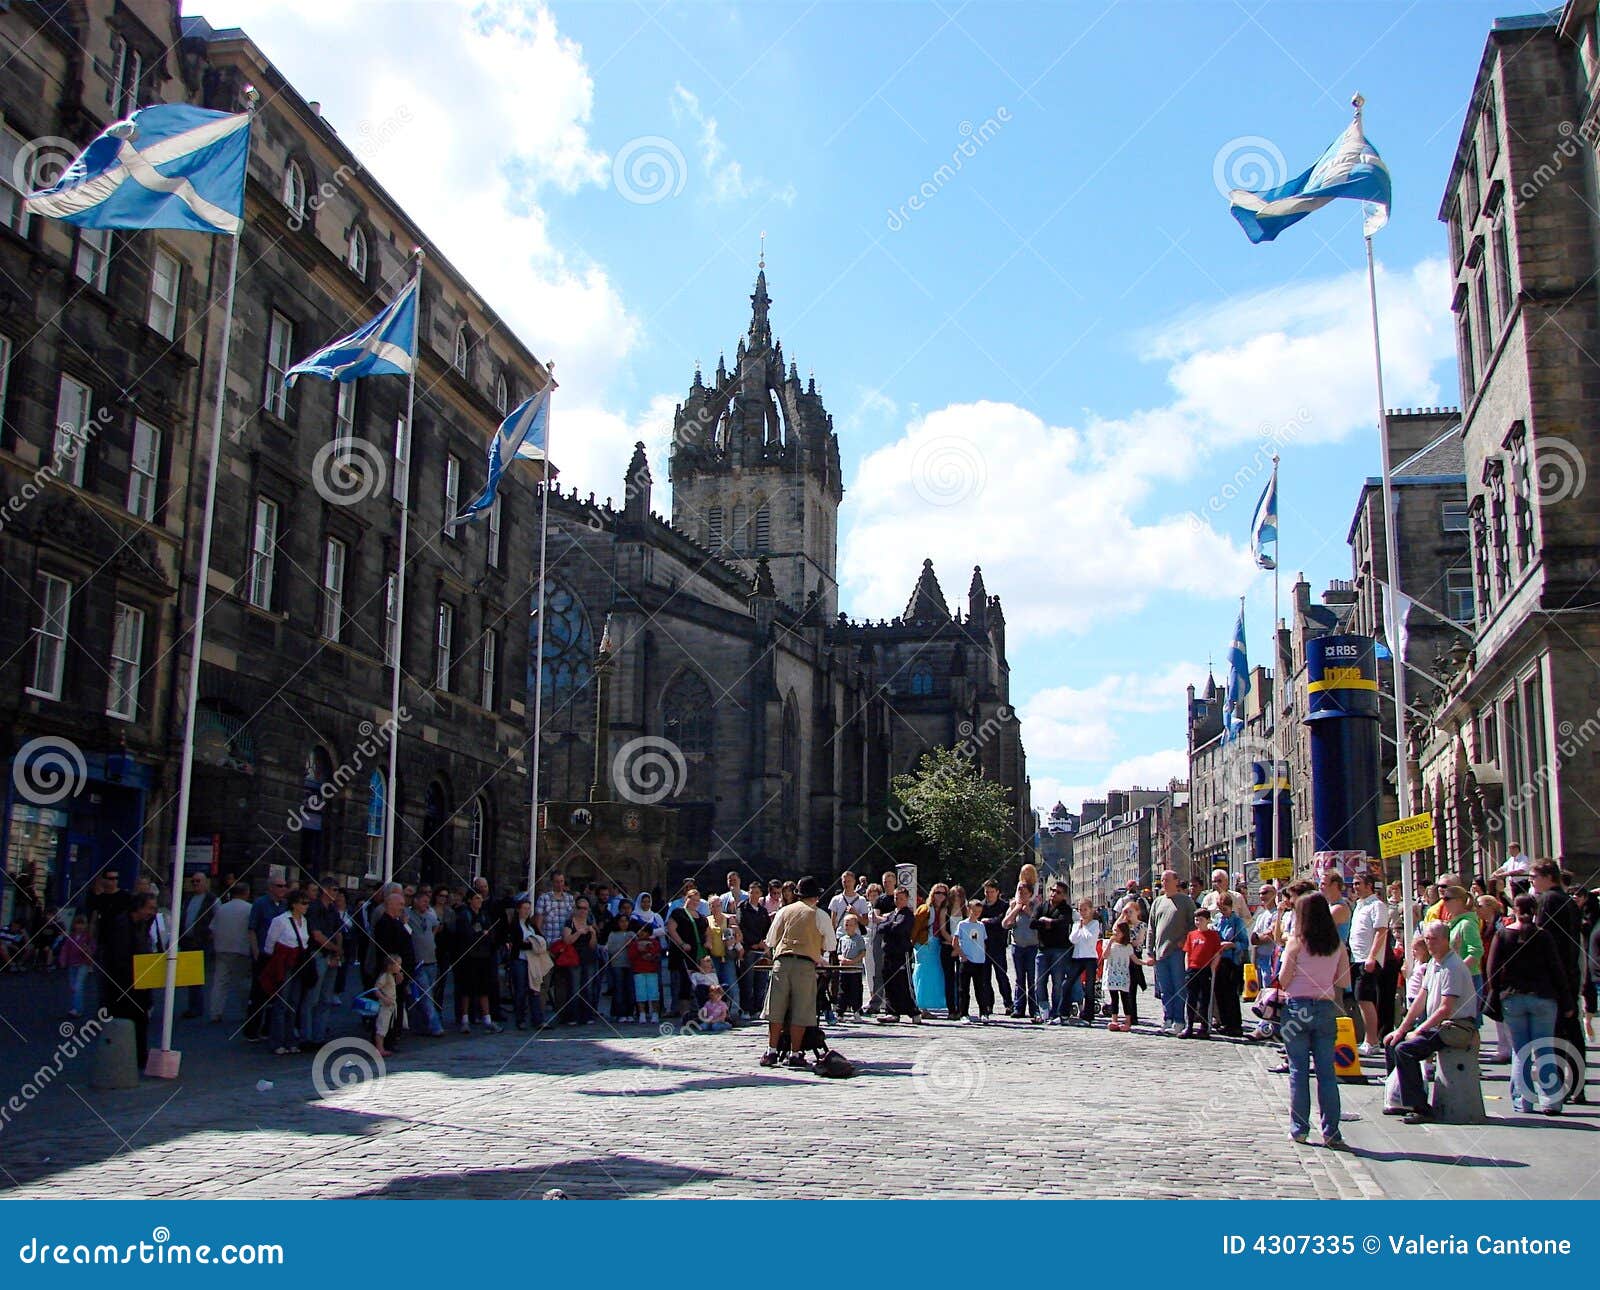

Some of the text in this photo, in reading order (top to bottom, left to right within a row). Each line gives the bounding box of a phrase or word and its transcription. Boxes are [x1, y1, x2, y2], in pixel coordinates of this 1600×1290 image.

[1336, 645, 1357, 656] RBS
[1381, 830, 1392, 840] NO
[1396, 820, 1429, 837] PARKING
